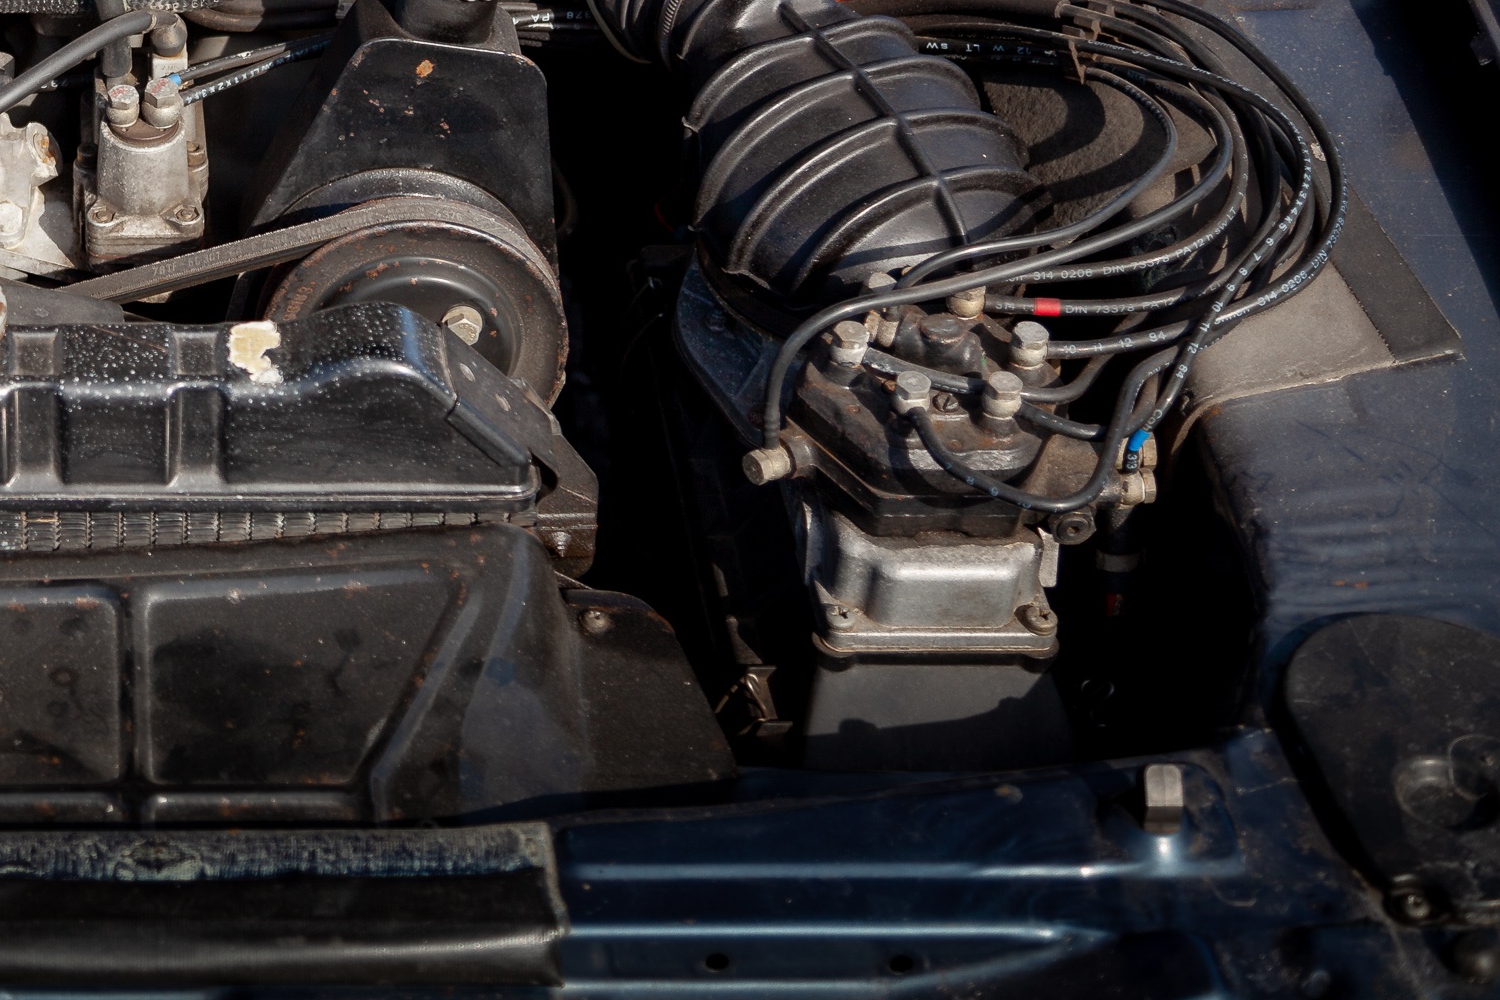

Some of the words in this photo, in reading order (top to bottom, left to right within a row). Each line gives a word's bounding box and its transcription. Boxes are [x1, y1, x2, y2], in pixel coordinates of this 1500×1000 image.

[926, 42, 949, 50] SW
[965, 43, 981, 52] LT
[1299, 191, 1307, 199] 3
[1278, 223, 1287, 231] 5
[1265, 237, 1274, 246] 6
[1033, 270, 1054, 281] 314
[1060, 268, 1093, 279] 0206
[1103, 264, 1125, 275] DIN
[1175, 246, 1192, 259] PA
[1192, 237, 1205, 248] 12
[1253, 252, 1262, 261] 7
[1238, 267, 1249, 276] 8
[1257, 292, 1277, 307] 314
[1312, 250, 1328, 267] DIN
[1226, 283, 1236, 293] 9
[1065, 304, 1088, 314] DIN
[1095, 303, 1135, 314] 73378
[1212, 300, 1224, 312] 10
[1063, 344, 1077, 354] 10
[1119, 338, 1132, 349] 12
[1148, 331, 1167, 342] 94
[1187, 342, 1199, 355] 12
[1175, 364, 1188, 379] 84
[1126, 453, 1138, 470] 313
